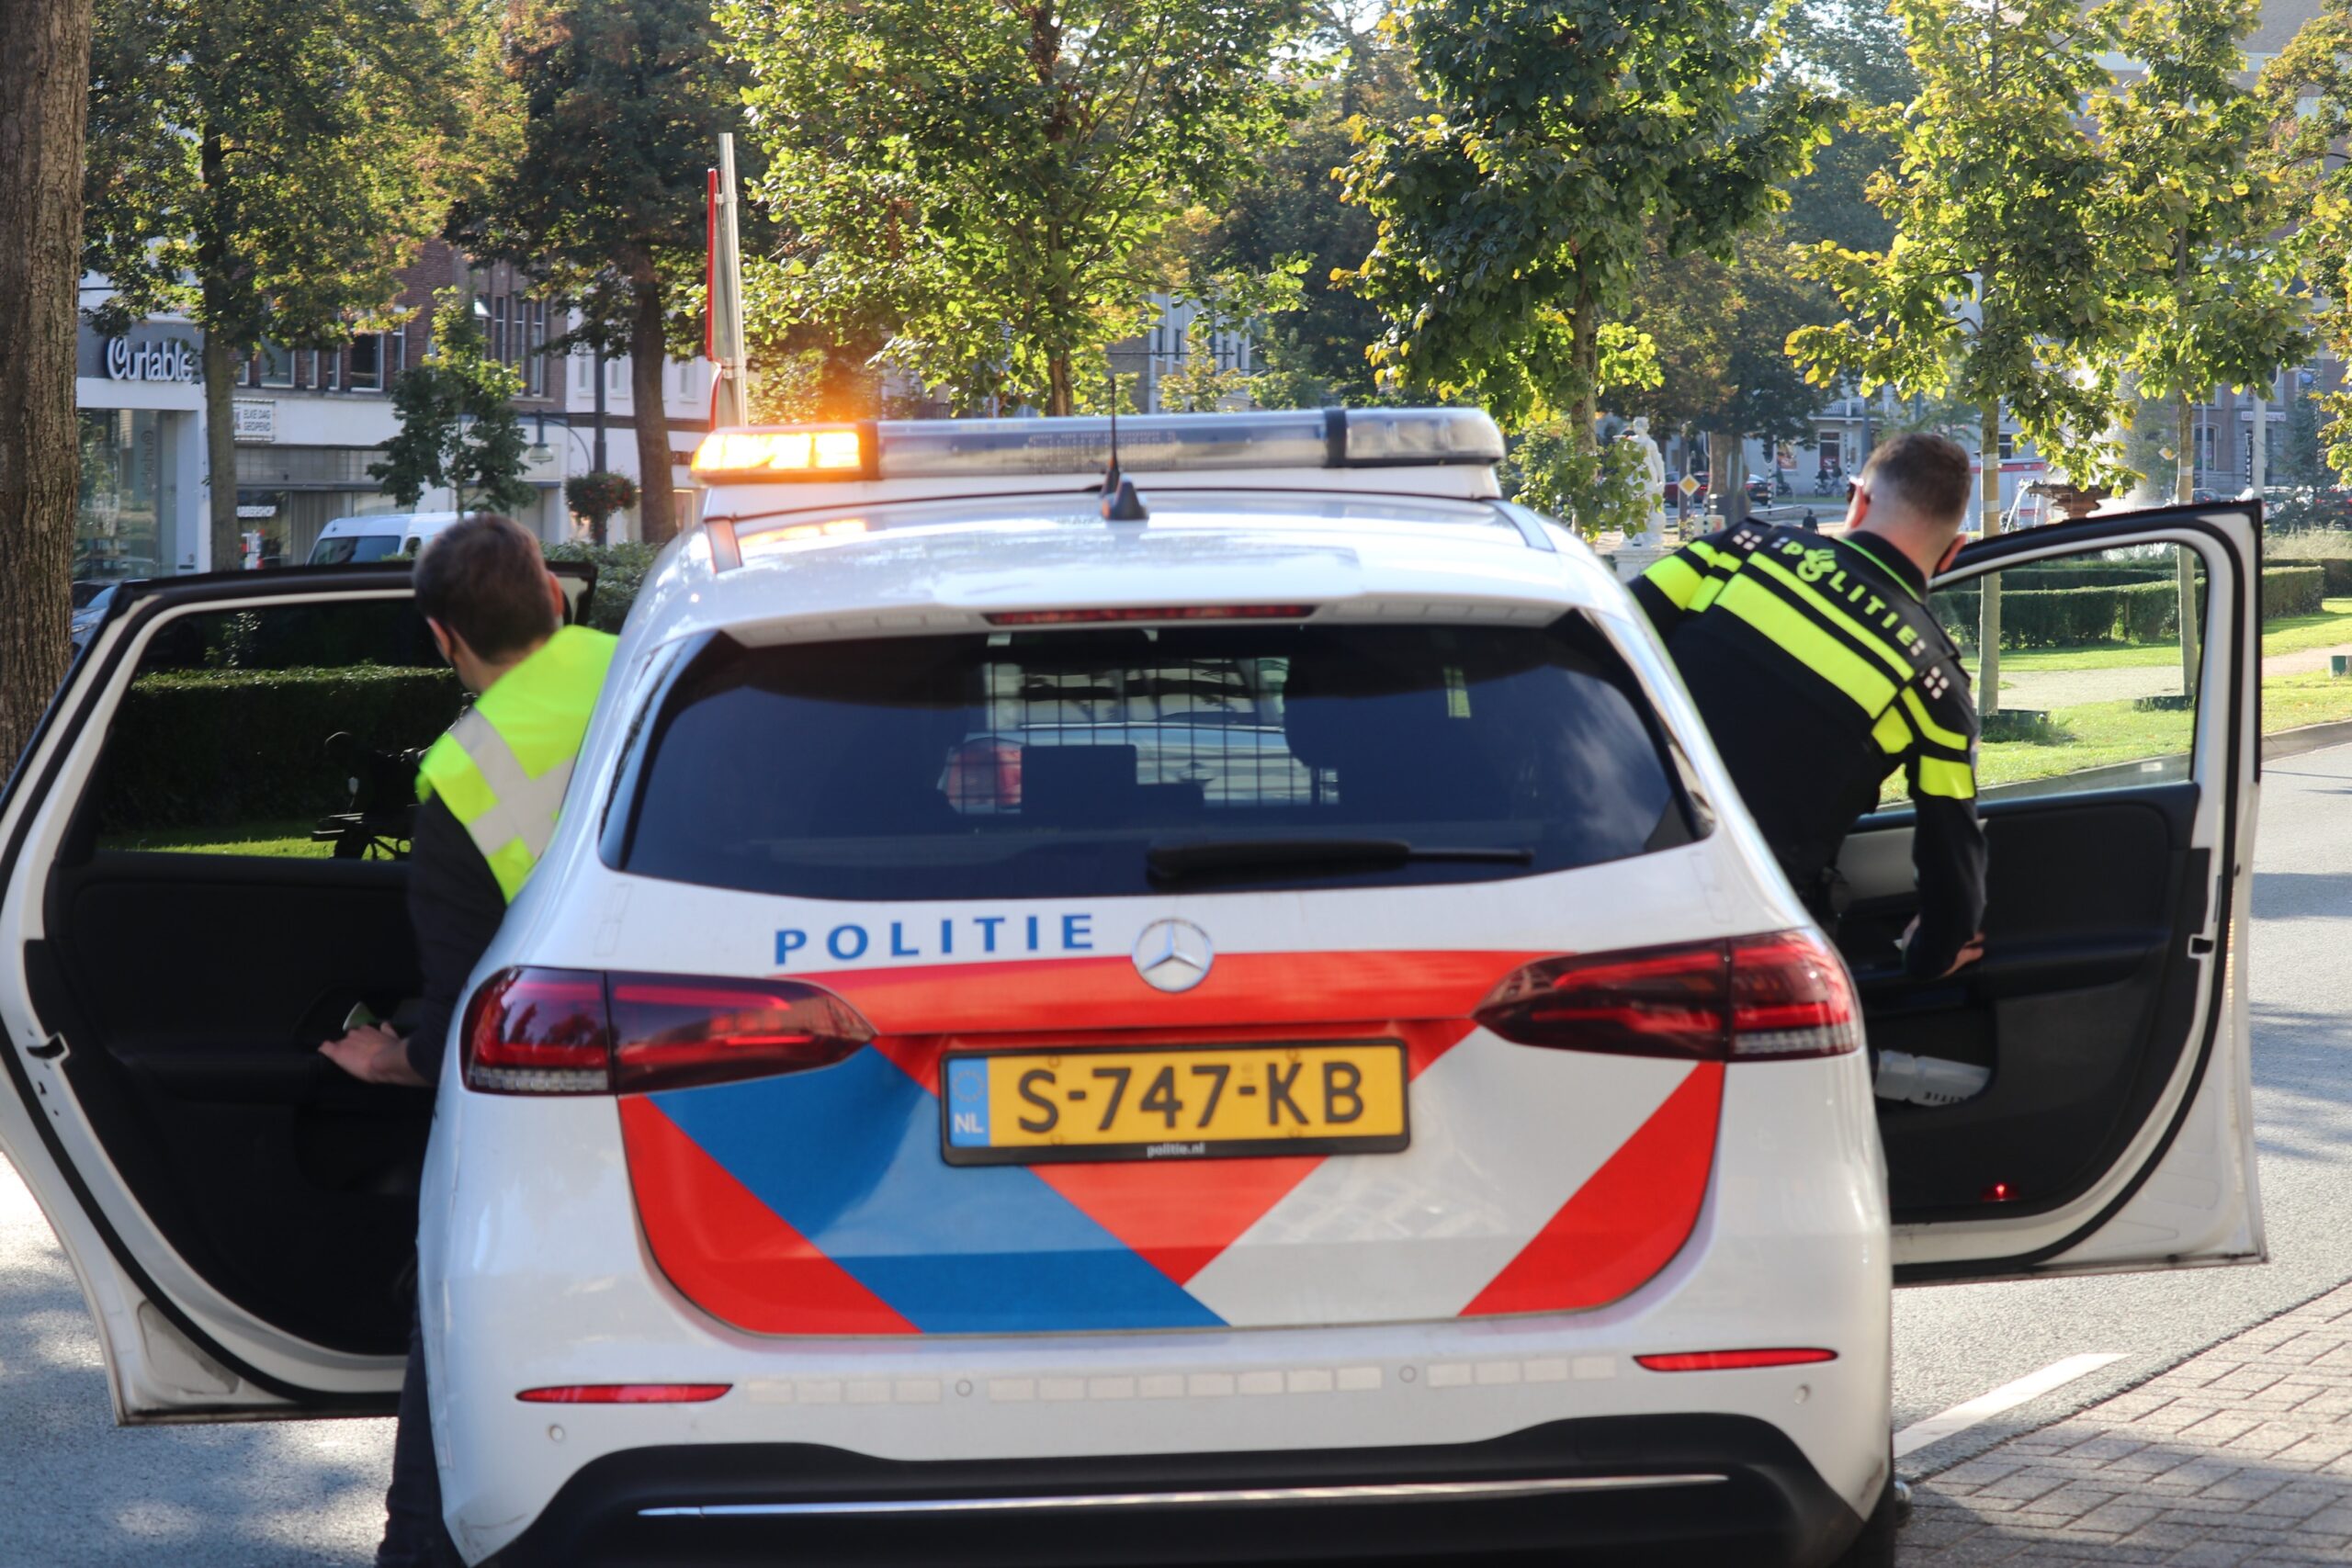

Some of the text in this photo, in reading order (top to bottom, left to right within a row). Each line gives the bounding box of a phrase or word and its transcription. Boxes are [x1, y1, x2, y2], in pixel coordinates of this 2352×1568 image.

[107, 336, 193, 381] Curlable
[1781, 540, 1918, 647] POLITIE
[775, 913, 1093, 965] POLITIE
[1017, 1061, 1364, 1134] S-747-KB
[954, 1112, 985, 1133] NL
[1147, 1142, 1205, 1159] politie.nl
